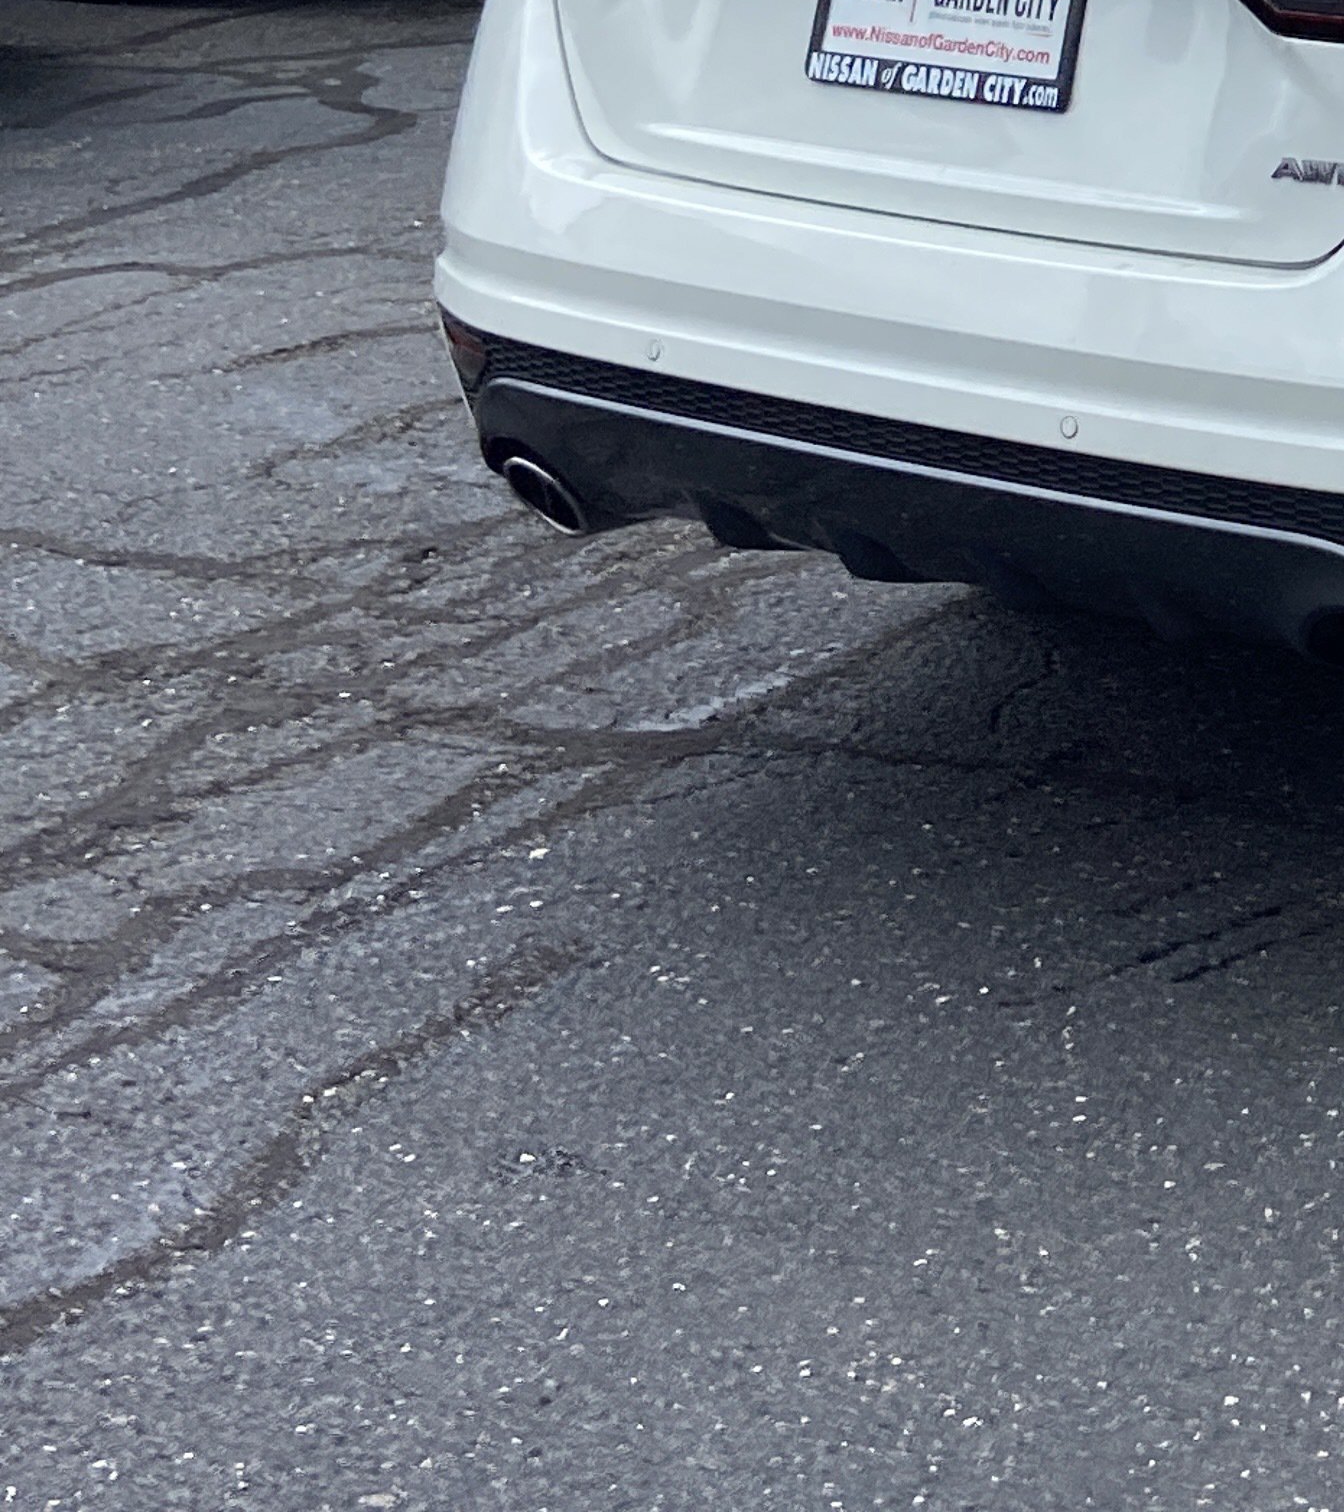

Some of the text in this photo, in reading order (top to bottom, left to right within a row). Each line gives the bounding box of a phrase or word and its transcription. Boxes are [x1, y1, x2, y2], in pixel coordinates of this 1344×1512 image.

[832, 24, 1050, 65] www.NissanofGardenCity.com
[808, 51, 1058, 109] NISSAN of GARDEN CITY.com
